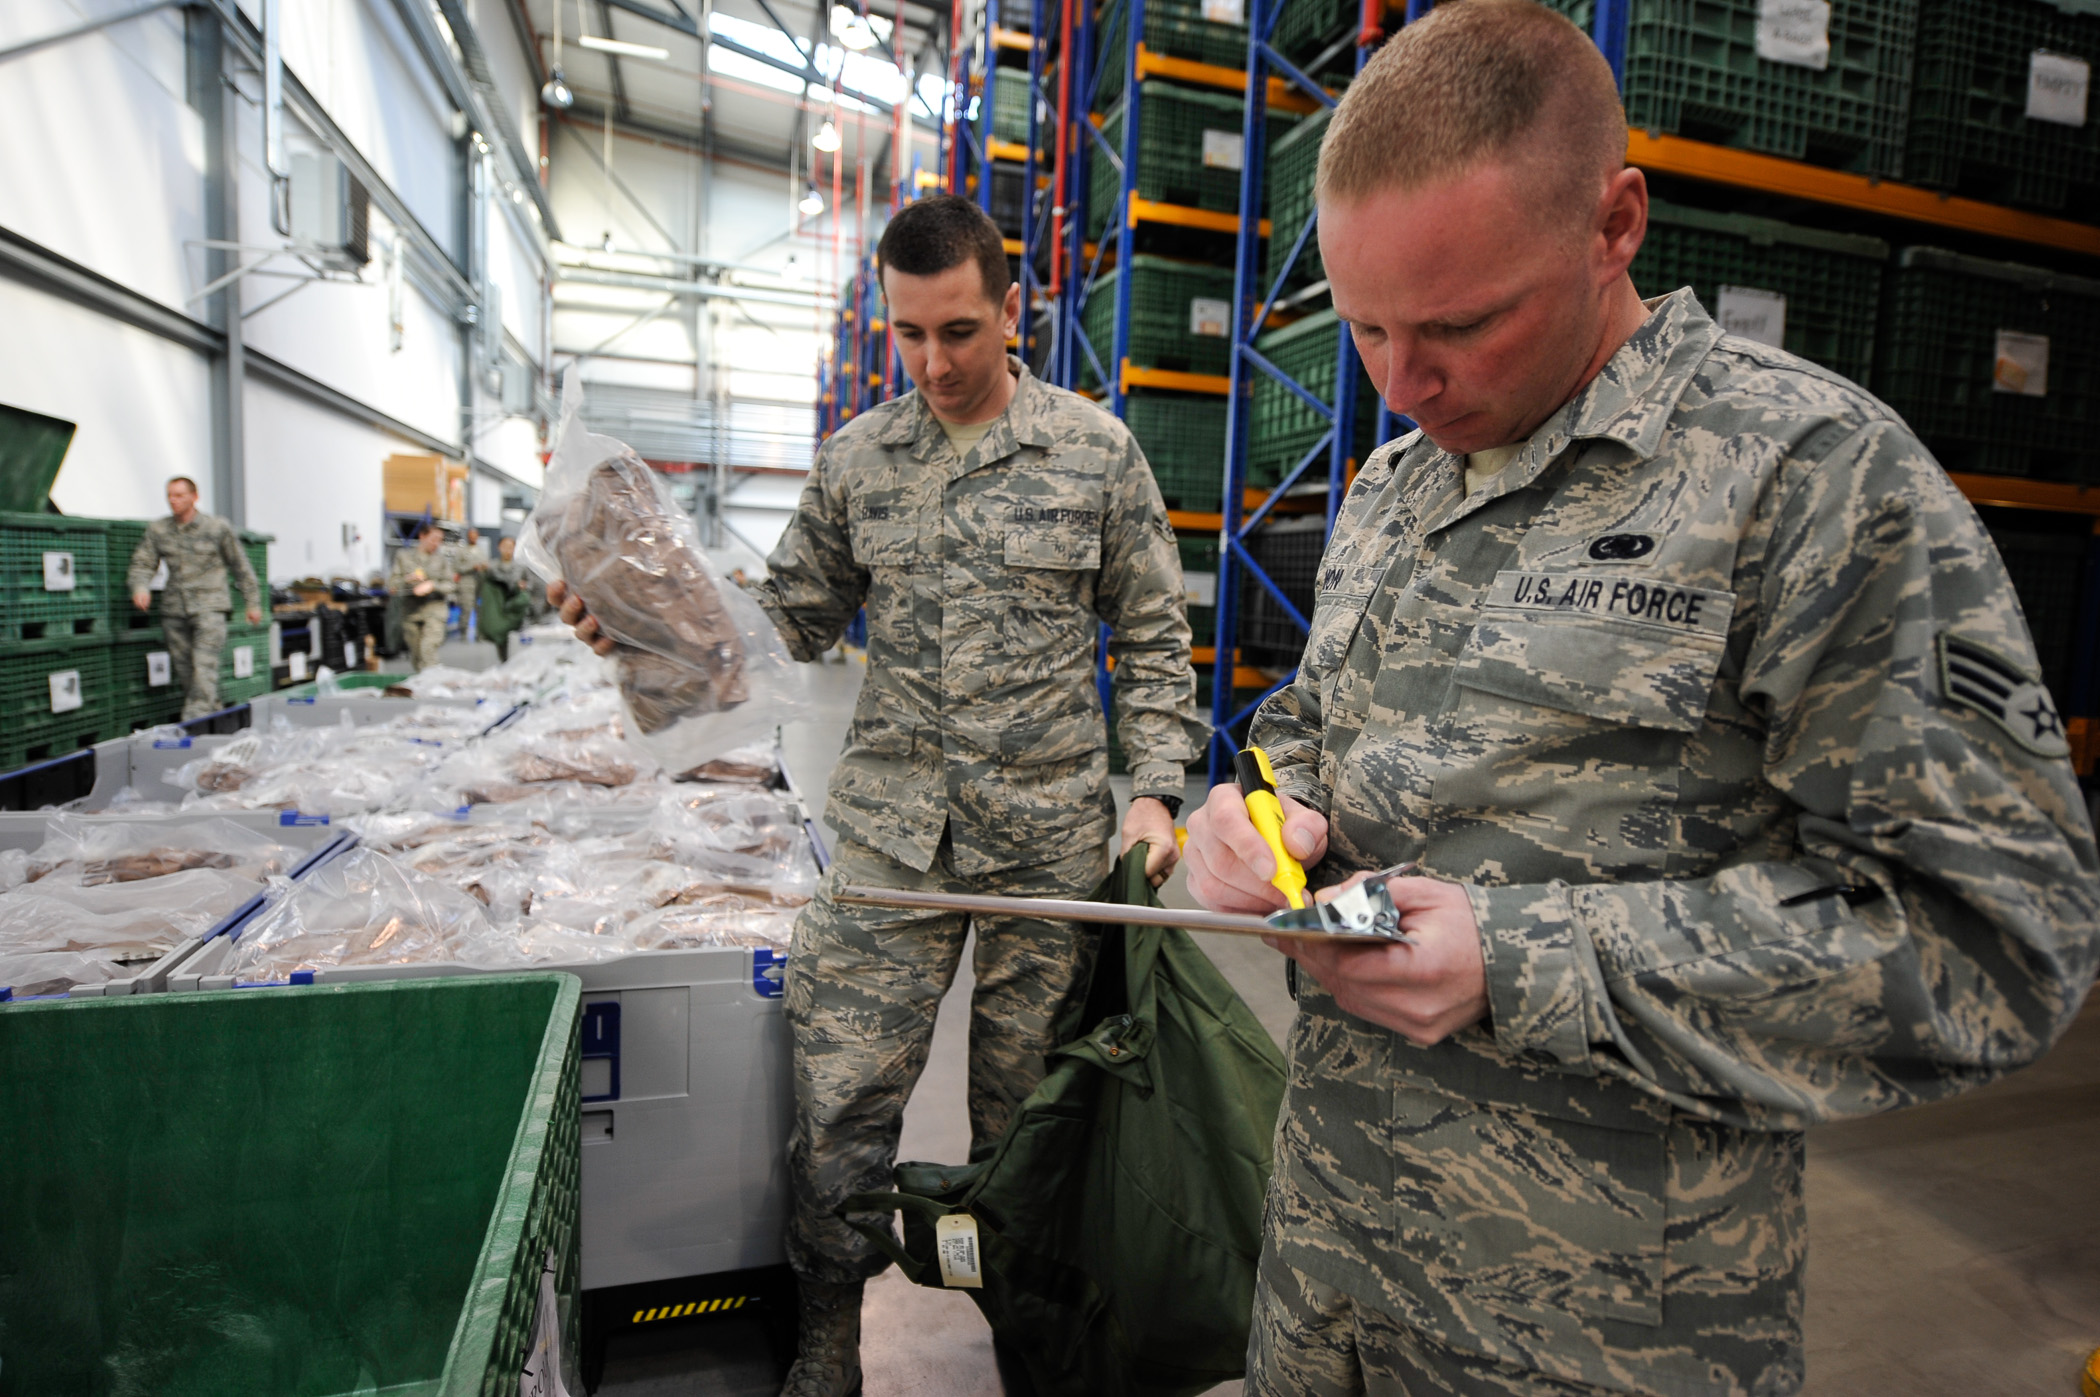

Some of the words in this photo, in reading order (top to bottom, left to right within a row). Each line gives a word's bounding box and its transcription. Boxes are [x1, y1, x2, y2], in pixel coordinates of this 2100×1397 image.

[1038, 508, 1059, 523] AIR
[1060, 508, 1097, 526] FORCE
[1513, 576, 1552, 605] U.S.
[1558, 578, 1603, 609] AIR
[1608, 580, 1707, 625] FORCE
